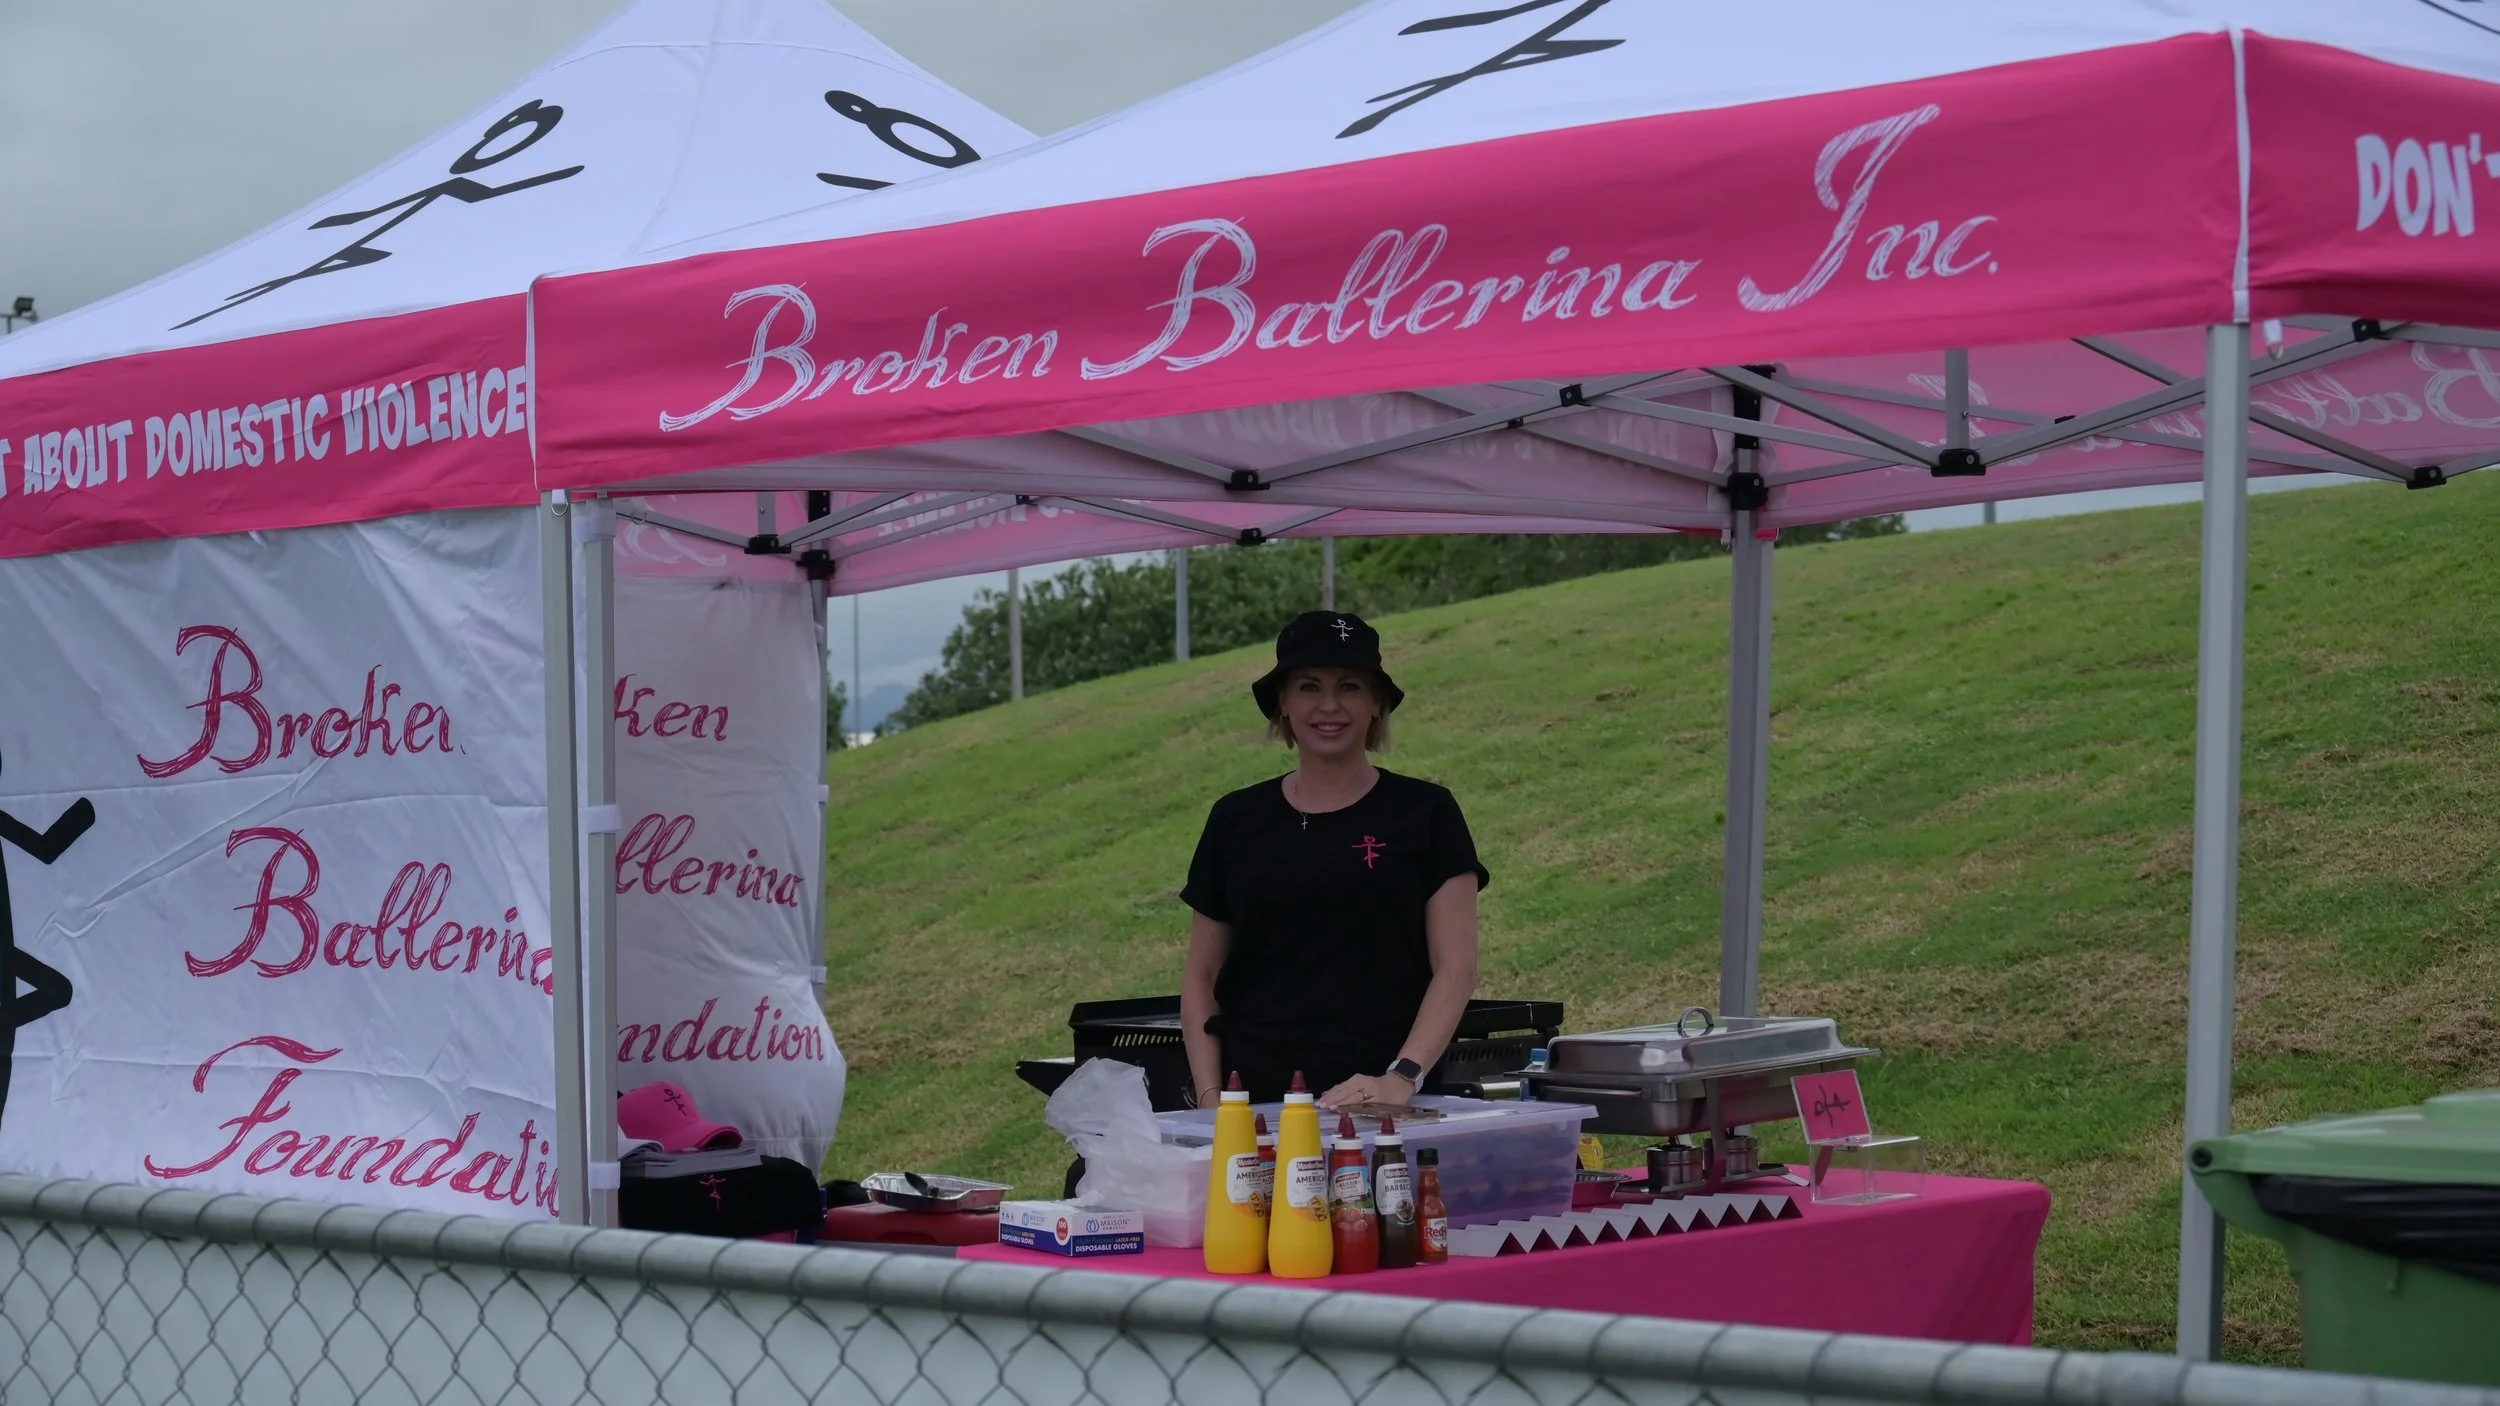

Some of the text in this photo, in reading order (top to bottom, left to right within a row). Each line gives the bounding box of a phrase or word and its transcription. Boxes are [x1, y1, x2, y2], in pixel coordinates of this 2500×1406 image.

[659, 104, 1998, 432] Broken Ballerina Inc.
[24, 419, 134, 496] ABOUT
[145, 393, 331, 479] DOMESTIC
[341, 365, 526, 456] VIOLENCE
[144, 1035, 560, 1218] Foundati
[1295, 1175, 1325, 1184] AMERIC
[1384, 1184, 1410, 1193] BARBEC
[1075, 1242, 1138, 1252] DISPOSABLE GLOVES
